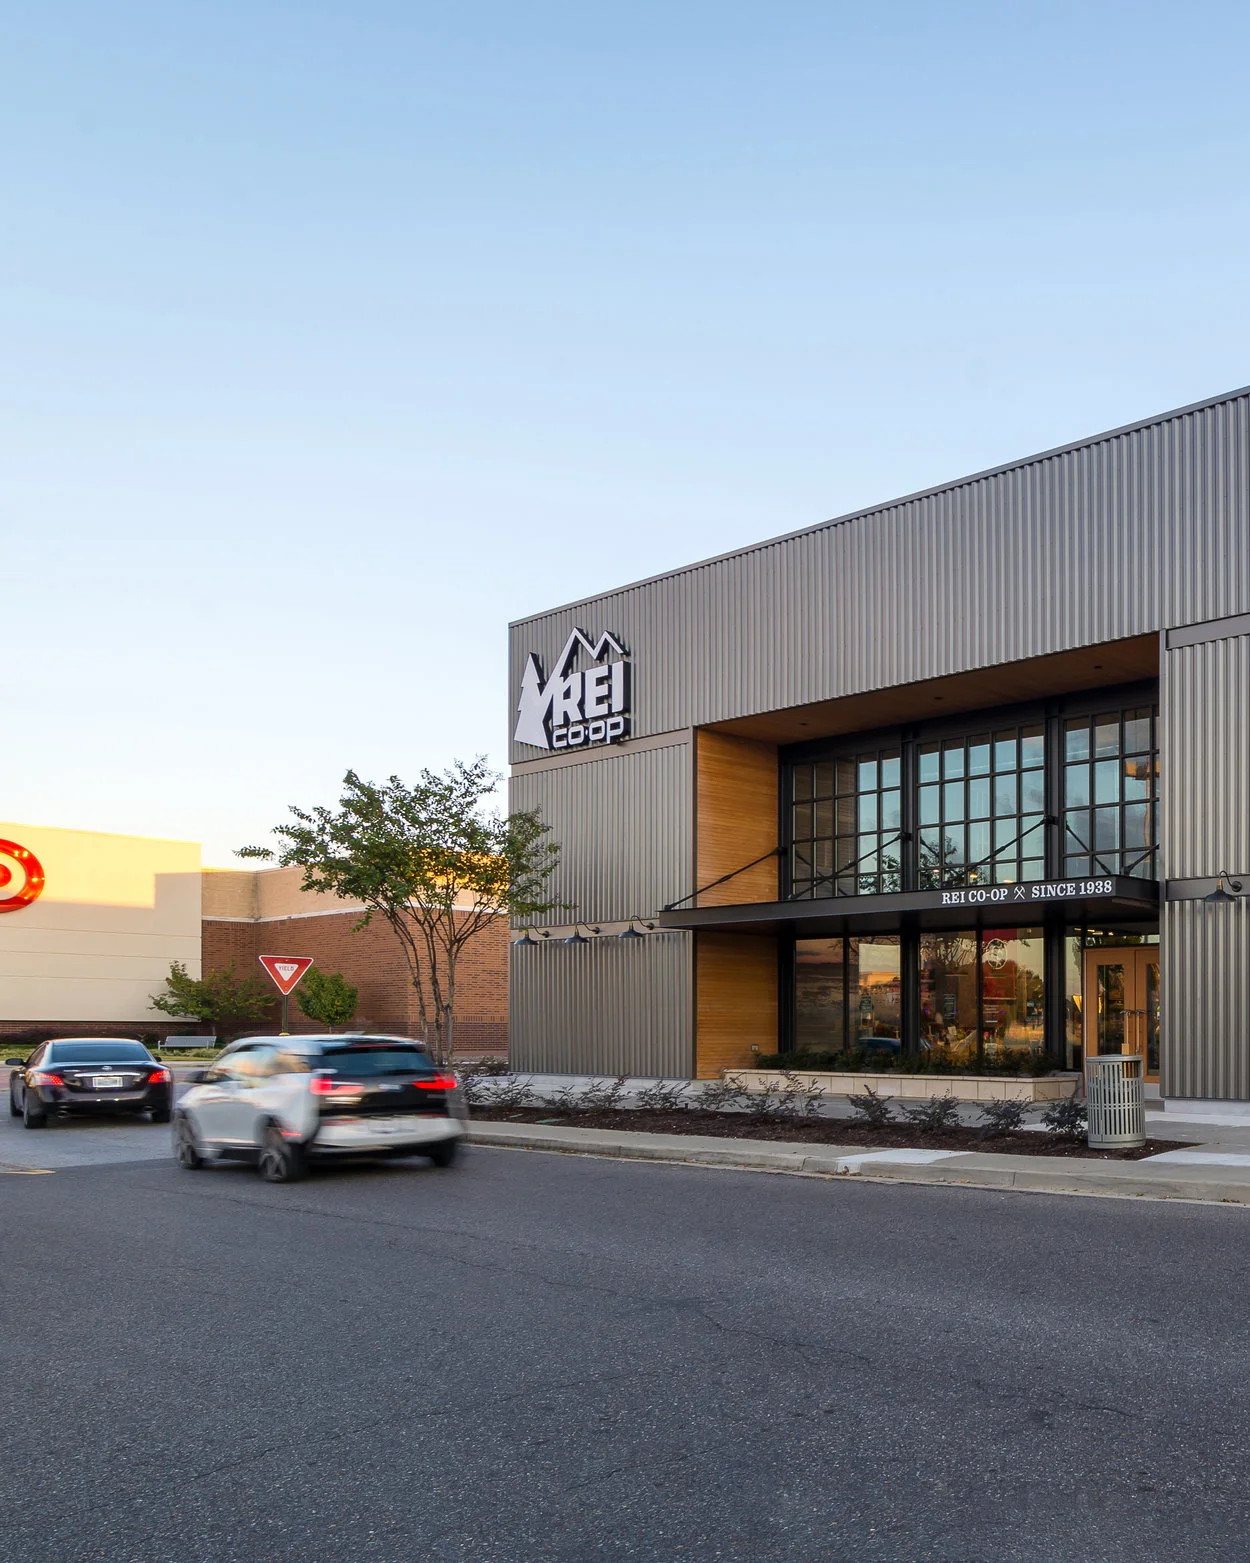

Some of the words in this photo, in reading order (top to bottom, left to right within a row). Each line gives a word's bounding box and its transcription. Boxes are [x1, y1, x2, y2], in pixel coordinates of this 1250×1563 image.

[552, 660, 624, 727] REI
[942, 891, 965, 904] REI
[968, 888, 1008, 903] CO-OP
[1031, 883, 1076, 898] SINCE
[1079, 880, 1112, 895] 1938
